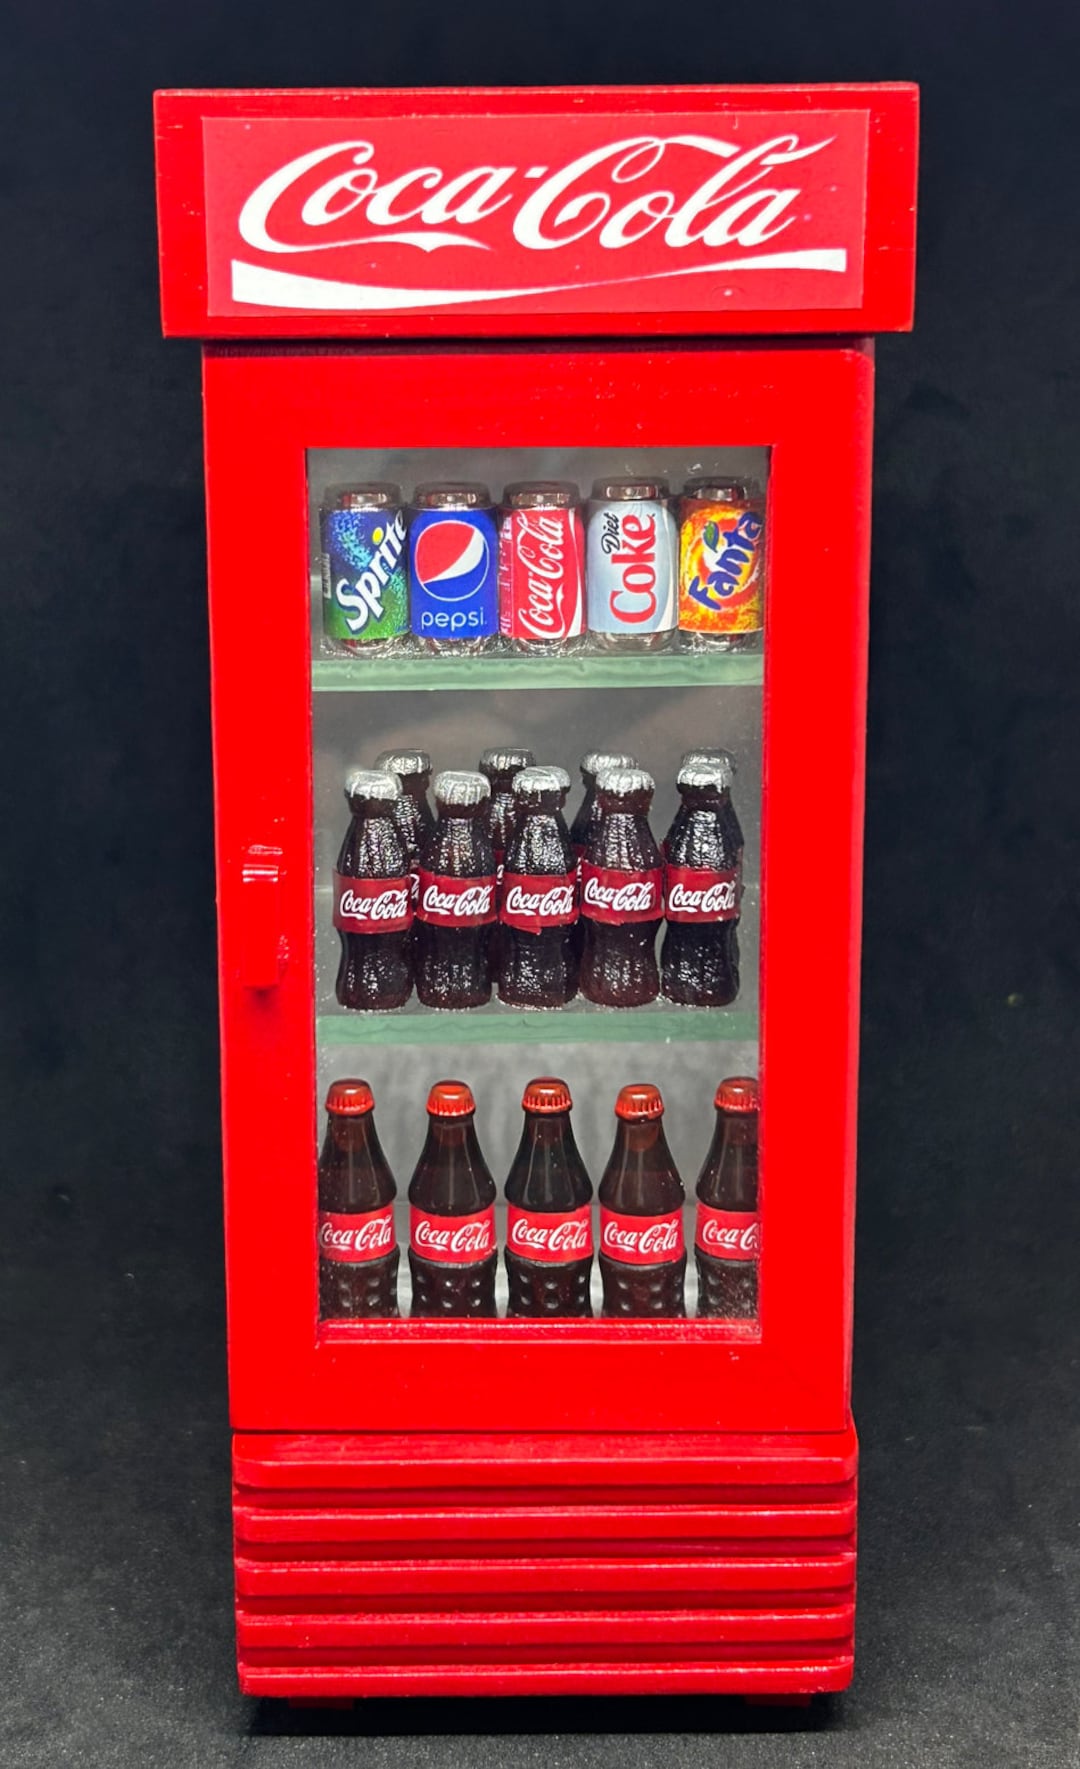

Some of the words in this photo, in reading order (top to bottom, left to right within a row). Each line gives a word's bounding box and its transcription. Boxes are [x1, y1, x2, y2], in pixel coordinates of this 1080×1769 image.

[238, 134, 837, 252] Coca-Cola
[601, 512, 620, 555] Diet
[335, 510, 408, 632] Sprite
[516, 510, 565, 639] Coca-Cola
[609, 514, 657, 624] Coke
[688, 511, 763, 611] Fanta
[421, 607, 485, 631] pepsi
[340, 888, 409, 920] Coca-Cola
[423, 885, 493, 916] Coca-Cola
[506, 885, 575, 916] Coca-Cola
[584, 877, 655, 911] Coca-Cola
[669, 880, 737, 913] Coca-Cola
[320, 1214, 393, 1251] Coca-Cola
[415, 1220, 490, 1253] Coca-Cola
[512, 1218, 589, 1251] Coca-Cola
[604, 1219, 679, 1254] Coca-Cola
[702, 1219, 759, 1250] Coca-C
